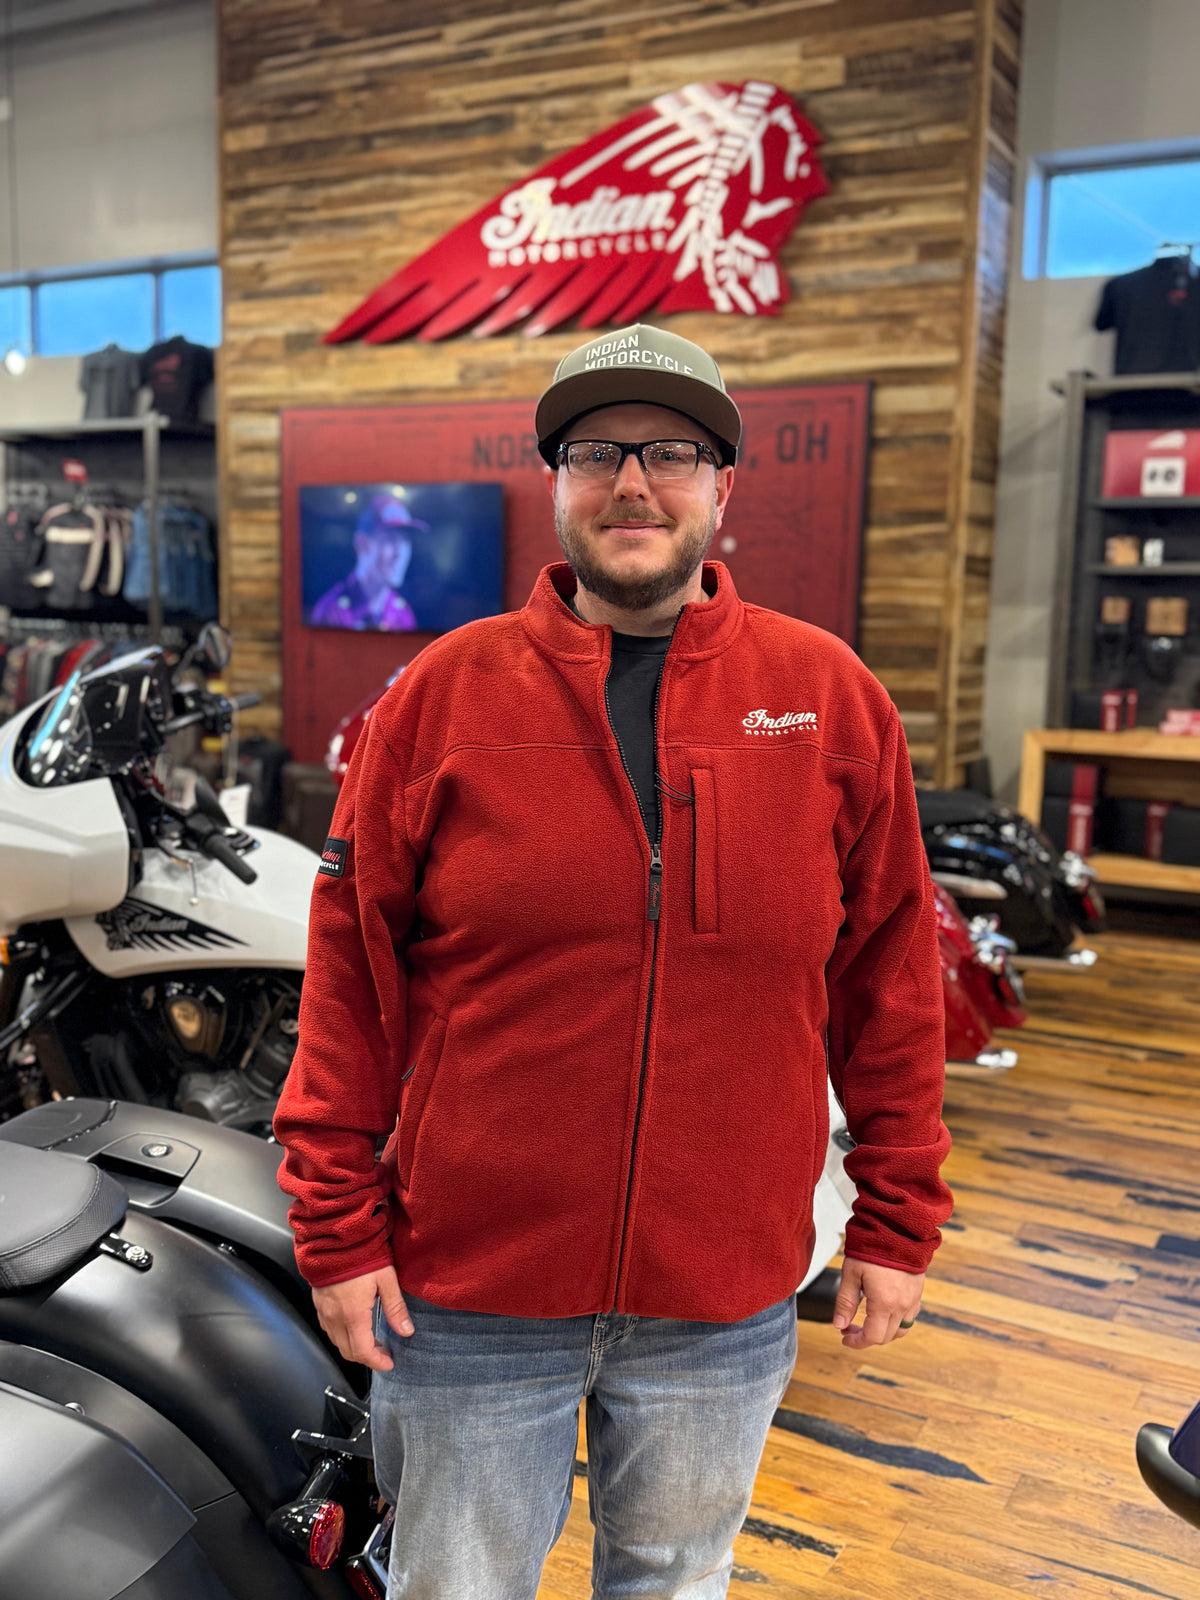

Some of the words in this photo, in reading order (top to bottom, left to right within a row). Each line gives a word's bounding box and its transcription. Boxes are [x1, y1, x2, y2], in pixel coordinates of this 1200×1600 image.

[480, 176, 675, 250] Indian
[487, 231, 666, 268] MOTORCYCLE
[586, 334, 639, 361] INDIAN
[471, 432, 539, 471] NOR
[777, 423, 830, 463] OH
[742, 709, 817, 729] Indian
[745, 724, 818, 736] MOTORCYCLE
